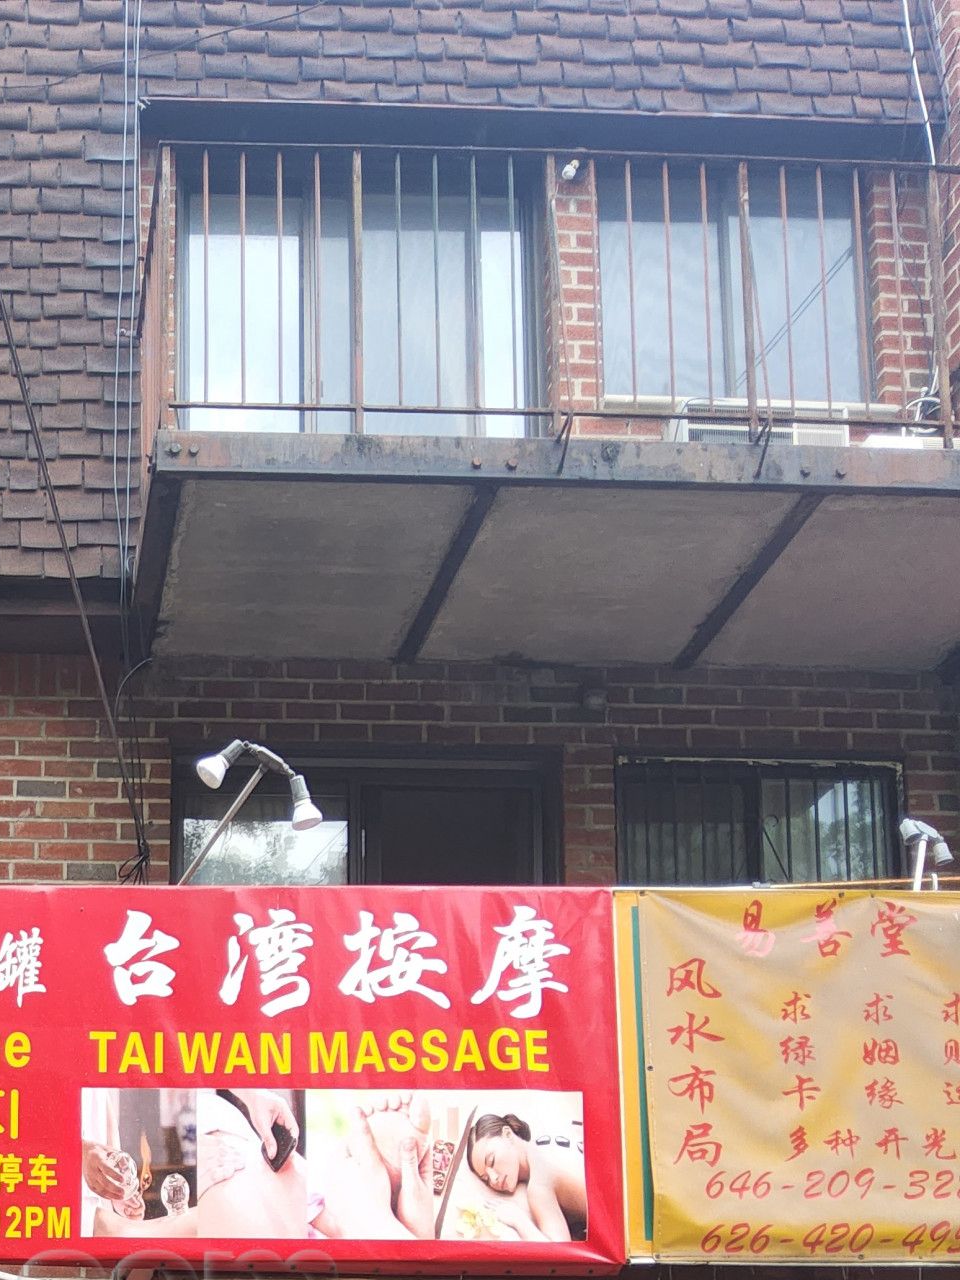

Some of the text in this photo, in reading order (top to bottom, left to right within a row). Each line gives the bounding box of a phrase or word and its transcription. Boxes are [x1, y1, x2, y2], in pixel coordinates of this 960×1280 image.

[103, 905, 572, 1019] 台湾按摩
[309, 1027, 550, 1073] MASSAGE
[666, 957, 726, 1168] 风水布局
[779, 991, 821, 1111] 求绿卡
[862, 992, 905, 1109] 求姻缘
[705, 1168, 960, 1201] 646-209-32
